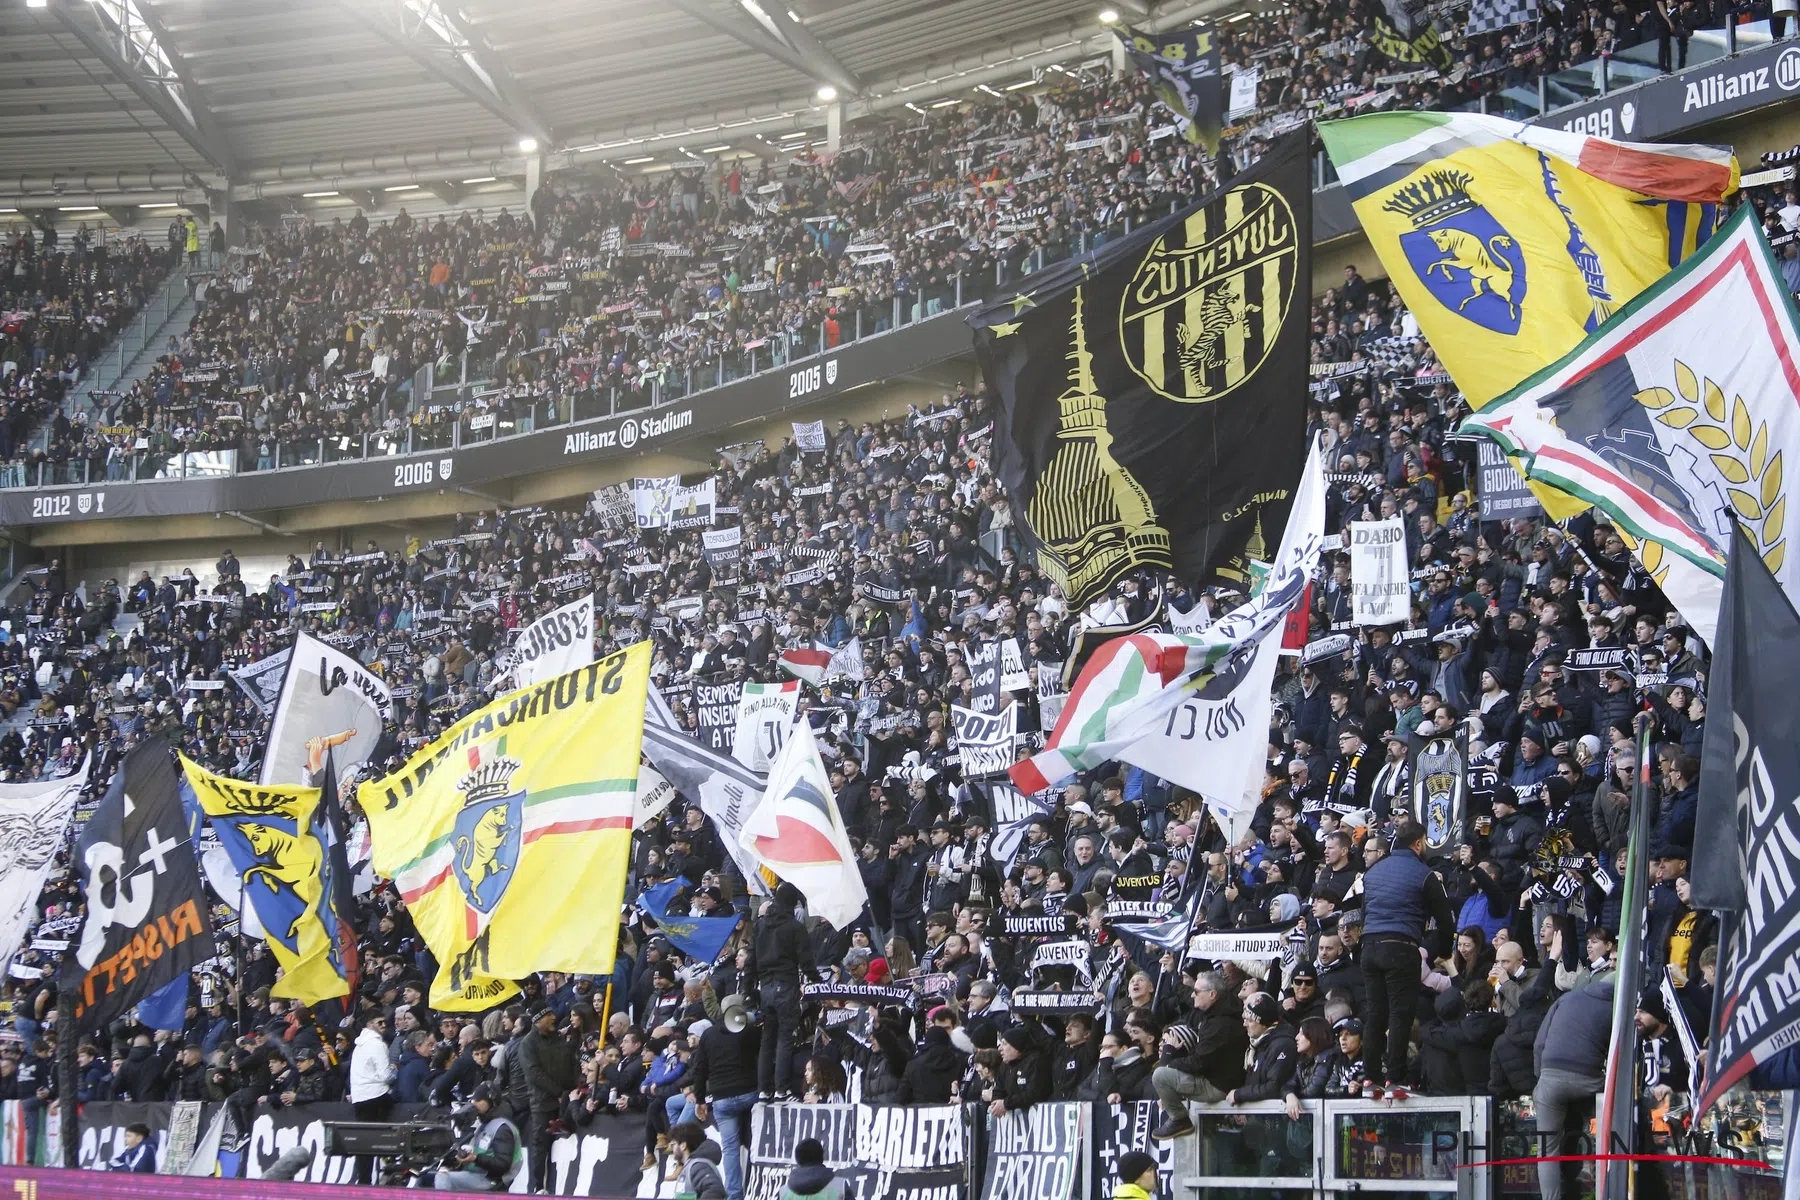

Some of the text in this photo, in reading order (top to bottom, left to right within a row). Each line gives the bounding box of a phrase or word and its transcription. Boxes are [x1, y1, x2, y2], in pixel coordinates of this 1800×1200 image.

[1683, 67, 1770, 113] Allianz
[1770, 232, 1794, 246] JUVENTUS
[826, 364, 838, 377] 28
[1416, 375, 1453, 385] JUVENTU
[790, 365, 821, 398] 2005
[563, 409, 693, 455] Allianz Stadium
[394, 463, 433, 487] 2006
[440, 461, 452, 475] 29
[33, 495, 71, 518] 2012
[79, 496, 91, 509] 30
[601, 492, 630, 506] GRUPPO
[671, 515, 710, 530] PRESENTE
[1354, 526, 1404, 545] DARIO
[1402, 628, 1428, 639] JUVENTUS
[1575, 649, 1624, 665] FINO ALLA FINE
[697, 681, 741, 705] SEMPRE
[744, 696, 791, 718] FINO ALLA FINE
[953, 705, 1011, 742] POPPI
[712, 729, 722, 748] A
[641, 787, 662, 809] CURVA
[716, 783, 744, 832] Agnelli
[1116, 874, 1161, 889] JUVENTUS
[1108, 900, 1142, 913] INTER
[1004, 915, 1066, 934] JUVENTUS
[1673, 927, 1693, 938] eep
[1034, 940, 1086, 962] JUVENTUS
[1014, 993, 1025, 1007] WE
[1025, 993, 1037, 1007] ARE
[1038, 993, 1060, 1008] YOUTH.
[1060, 992, 1080, 1007] SINCE
[757, 1103, 854, 1163] ANDRIA
[856, 1103, 965, 1168] BARLETTA
[994, 1103, 1078, 1153] MANU E
[989, 1154, 1068, 1200] ENRICO
